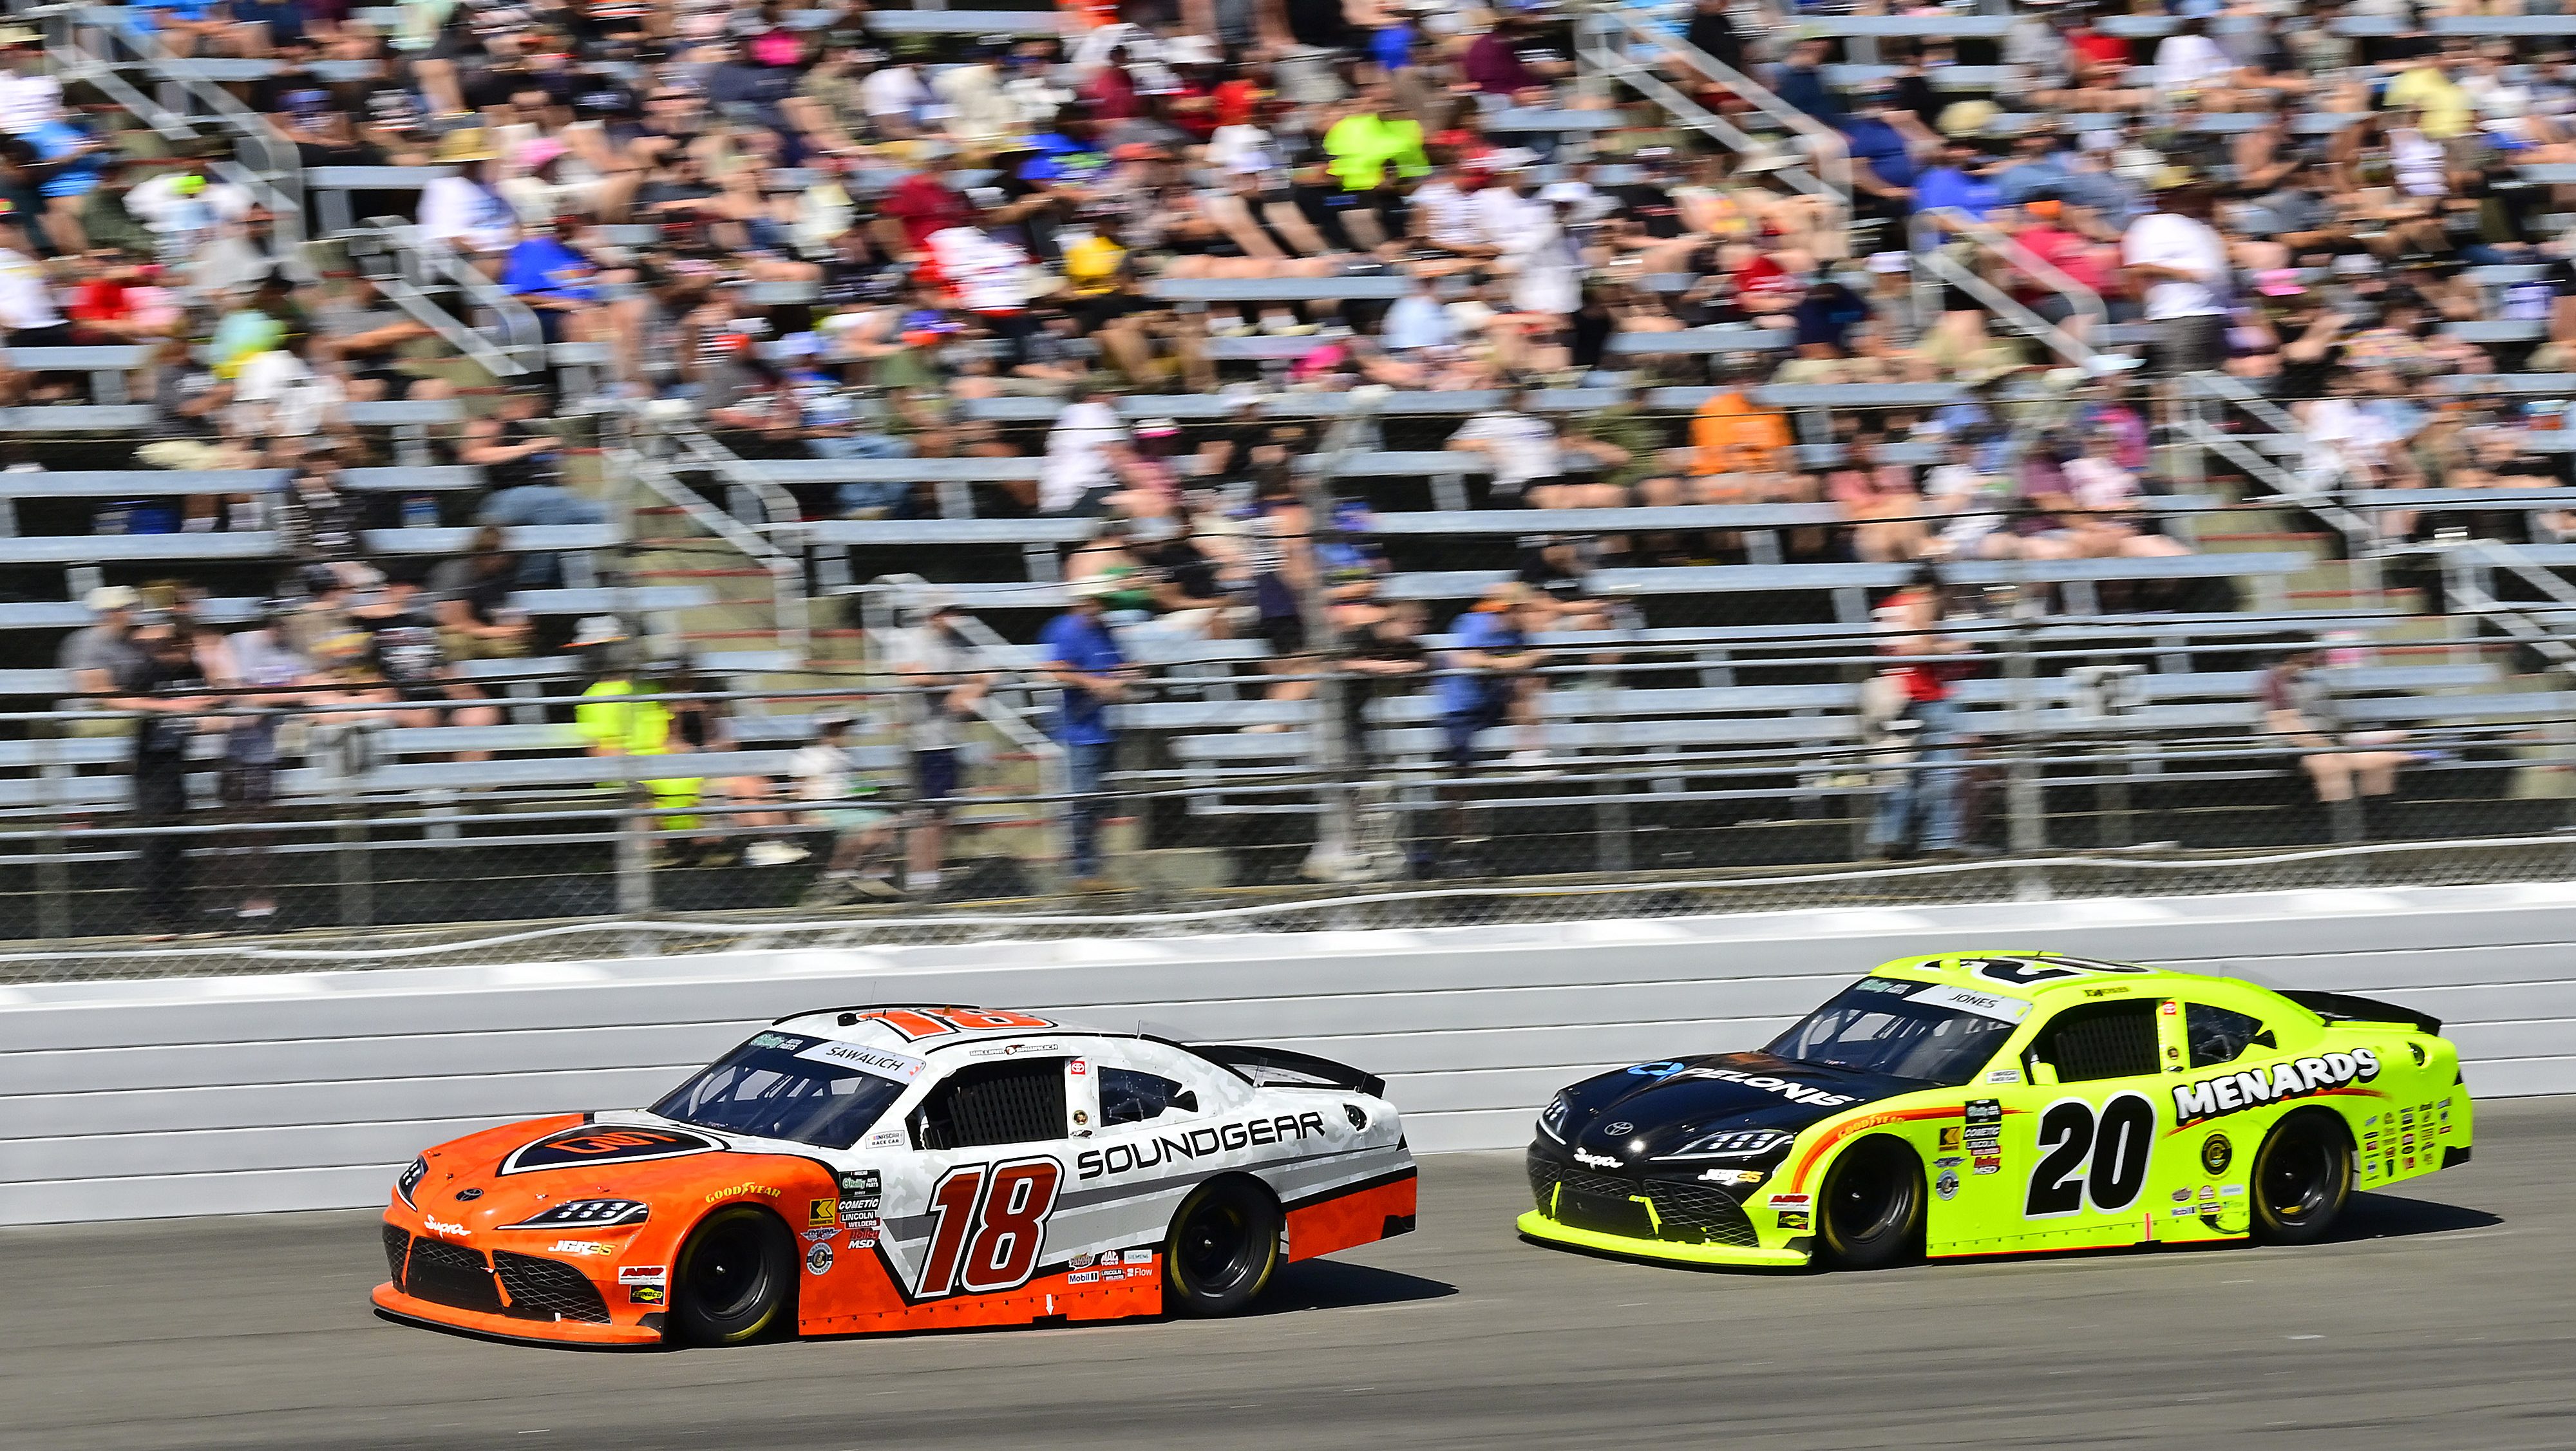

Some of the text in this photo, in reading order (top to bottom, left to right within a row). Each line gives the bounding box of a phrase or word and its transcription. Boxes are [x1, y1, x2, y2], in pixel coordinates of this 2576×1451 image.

[1947, 994, 1999, 1009] JONES
[857, 1008, 1054, 1038] 18
[826, 1047, 905, 1072] SAWALICH
[1674, 1068, 1857, 1106] PELONIS
[2173, 1048, 2381, 1124] MENARDS
[1077, 1111, 1327, 1181] SOUNDGEAR
[2025, 1094, 2154, 1216] 20
[705, 1182, 781, 1203] GOODYEAR
[838, 1197, 879, 1210] COMETIC
[424, 1214, 471, 1239] Supra
[842, 1211, 874, 1221] LINCOLN
[914, 1157, 1063, 1299] 18
[848, 1240, 876, 1249] MSD
[1069, 1273, 1090, 1283] Mobil
[1134, 1267, 1153, 1277] Flow
[632, 1290, 663, 1298] SUNOCO
